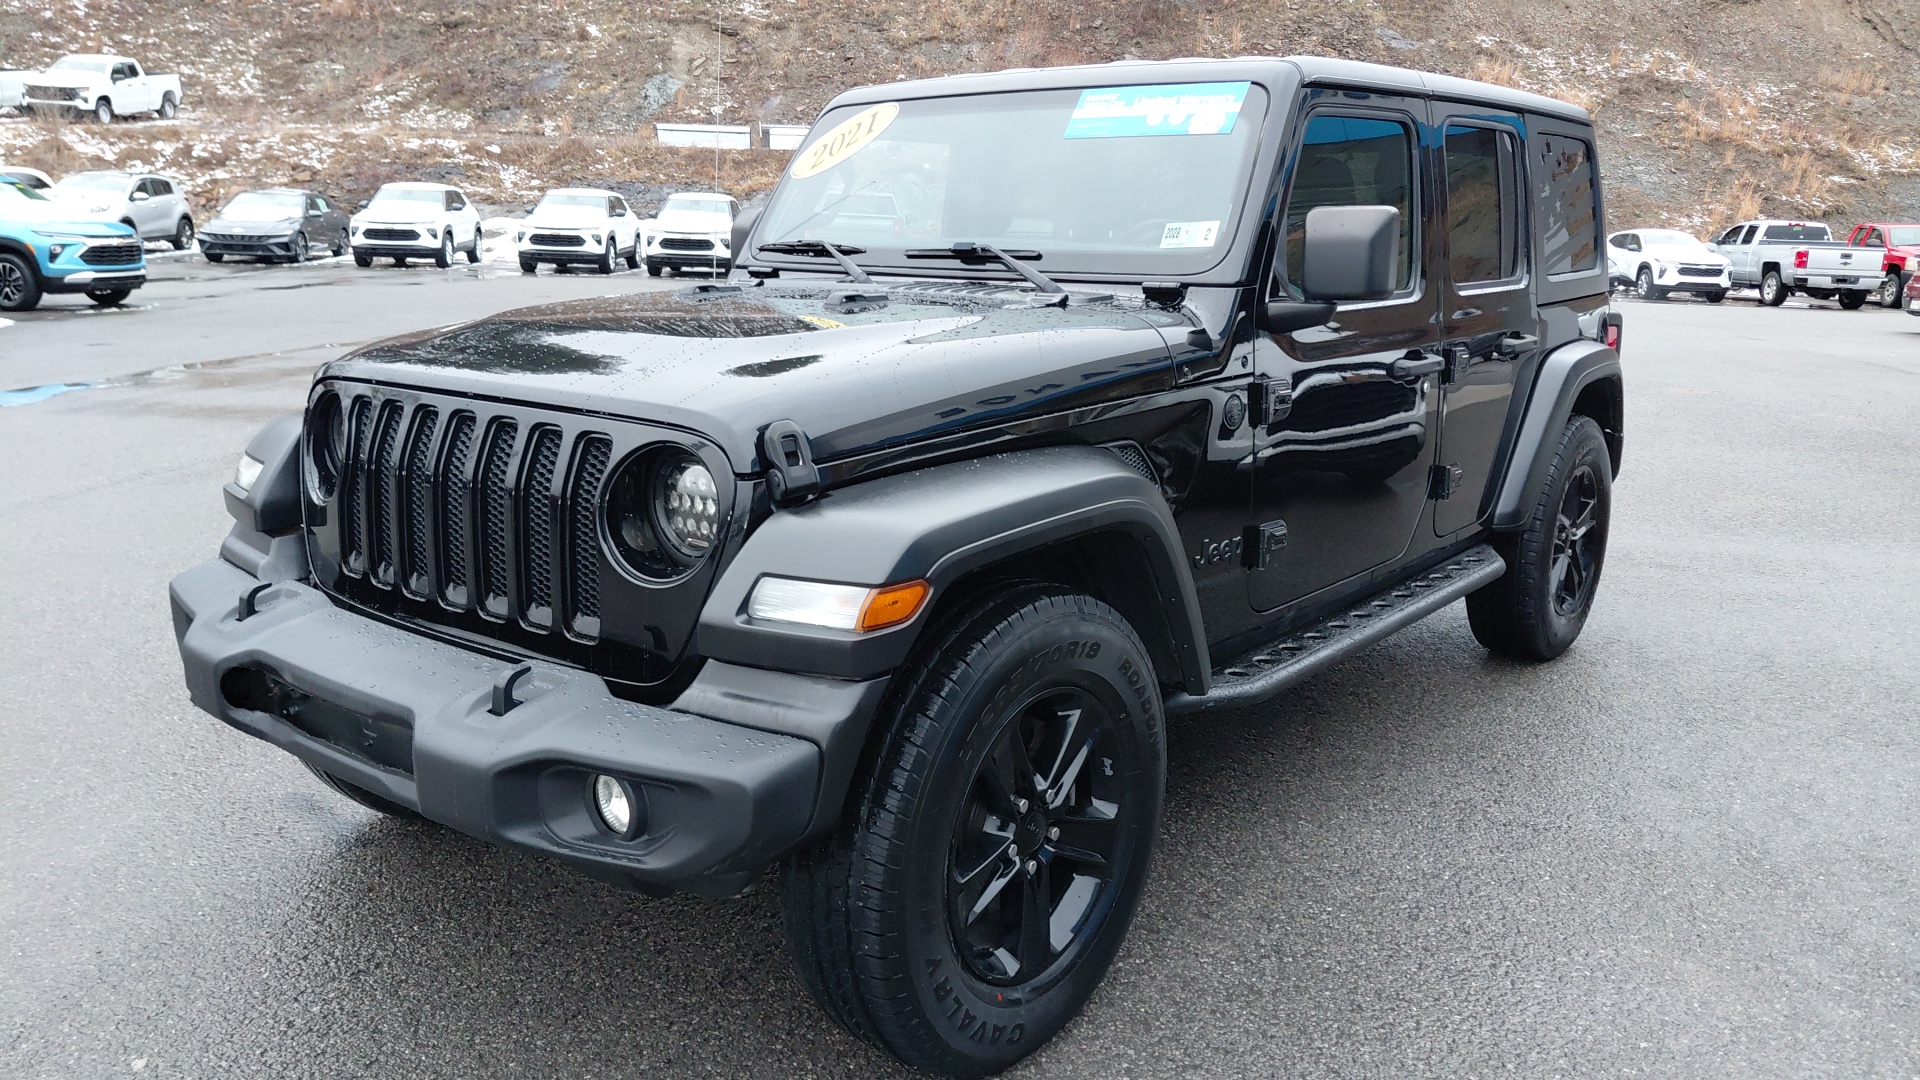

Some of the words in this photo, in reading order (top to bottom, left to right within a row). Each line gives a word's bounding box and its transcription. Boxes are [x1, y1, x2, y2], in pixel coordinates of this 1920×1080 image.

[810, 111, 879, 171] 2021
[1203, 227, 1212, 241] 2
[1193, 536, 1242, 569] Jeep
[925, 955, 1025, 1045] CAVALRY
